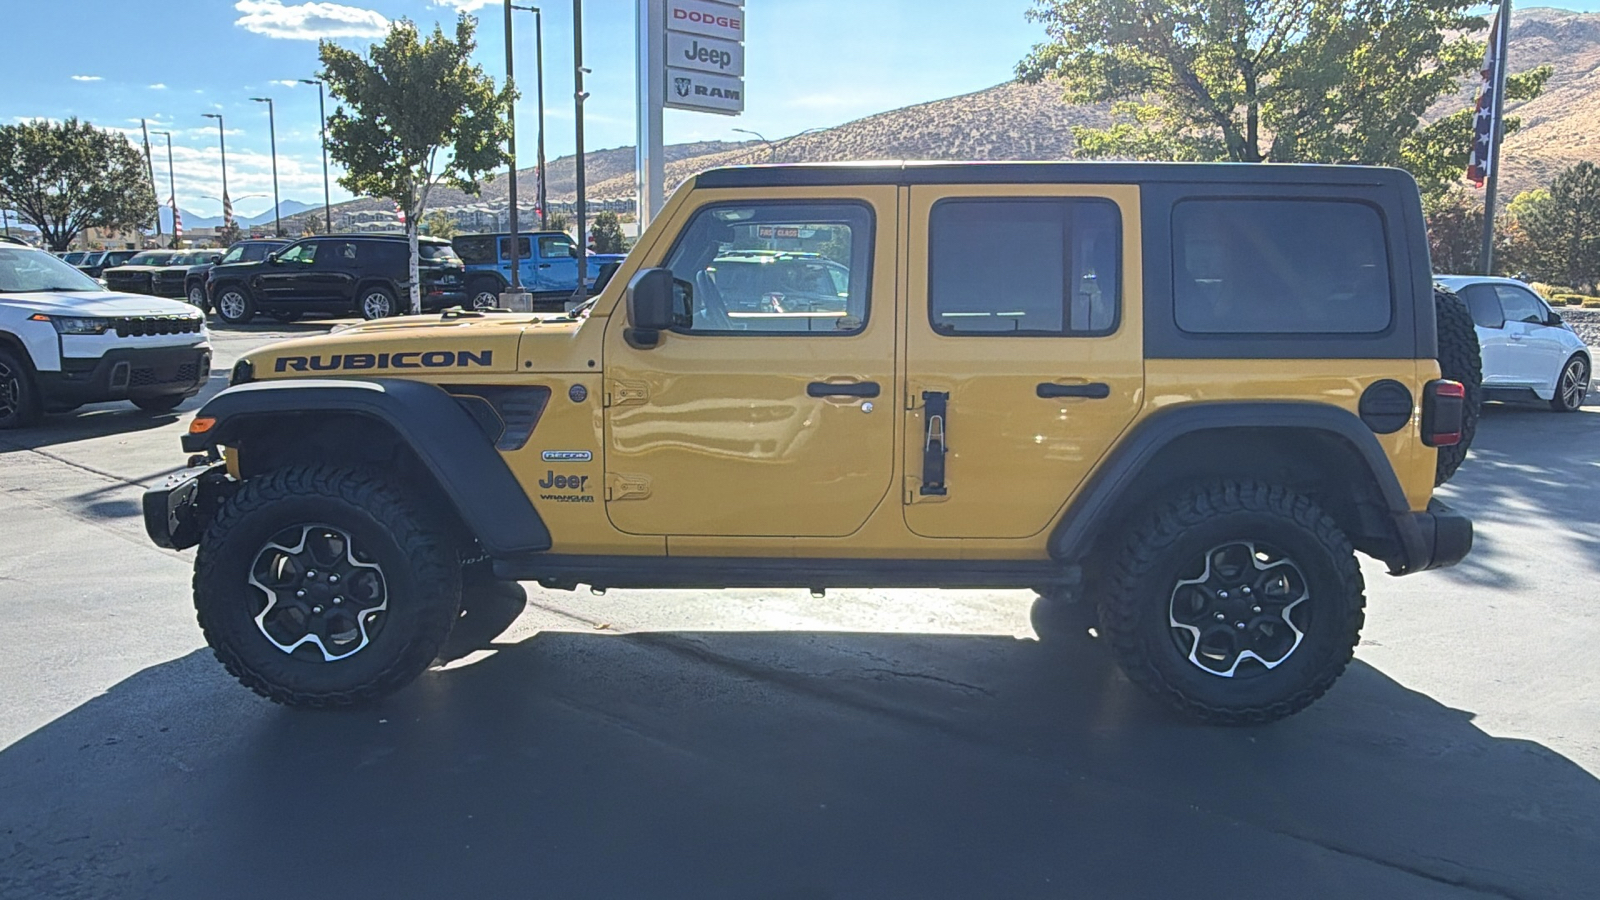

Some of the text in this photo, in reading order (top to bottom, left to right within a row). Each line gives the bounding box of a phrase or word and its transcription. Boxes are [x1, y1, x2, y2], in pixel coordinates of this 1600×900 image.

[673, 8, 741, 30] DODGE
[684, 40, 731, 69] Jeep
[694, 85, 740, 100] RAM
[274, 350, 493, 373] RUBICON
